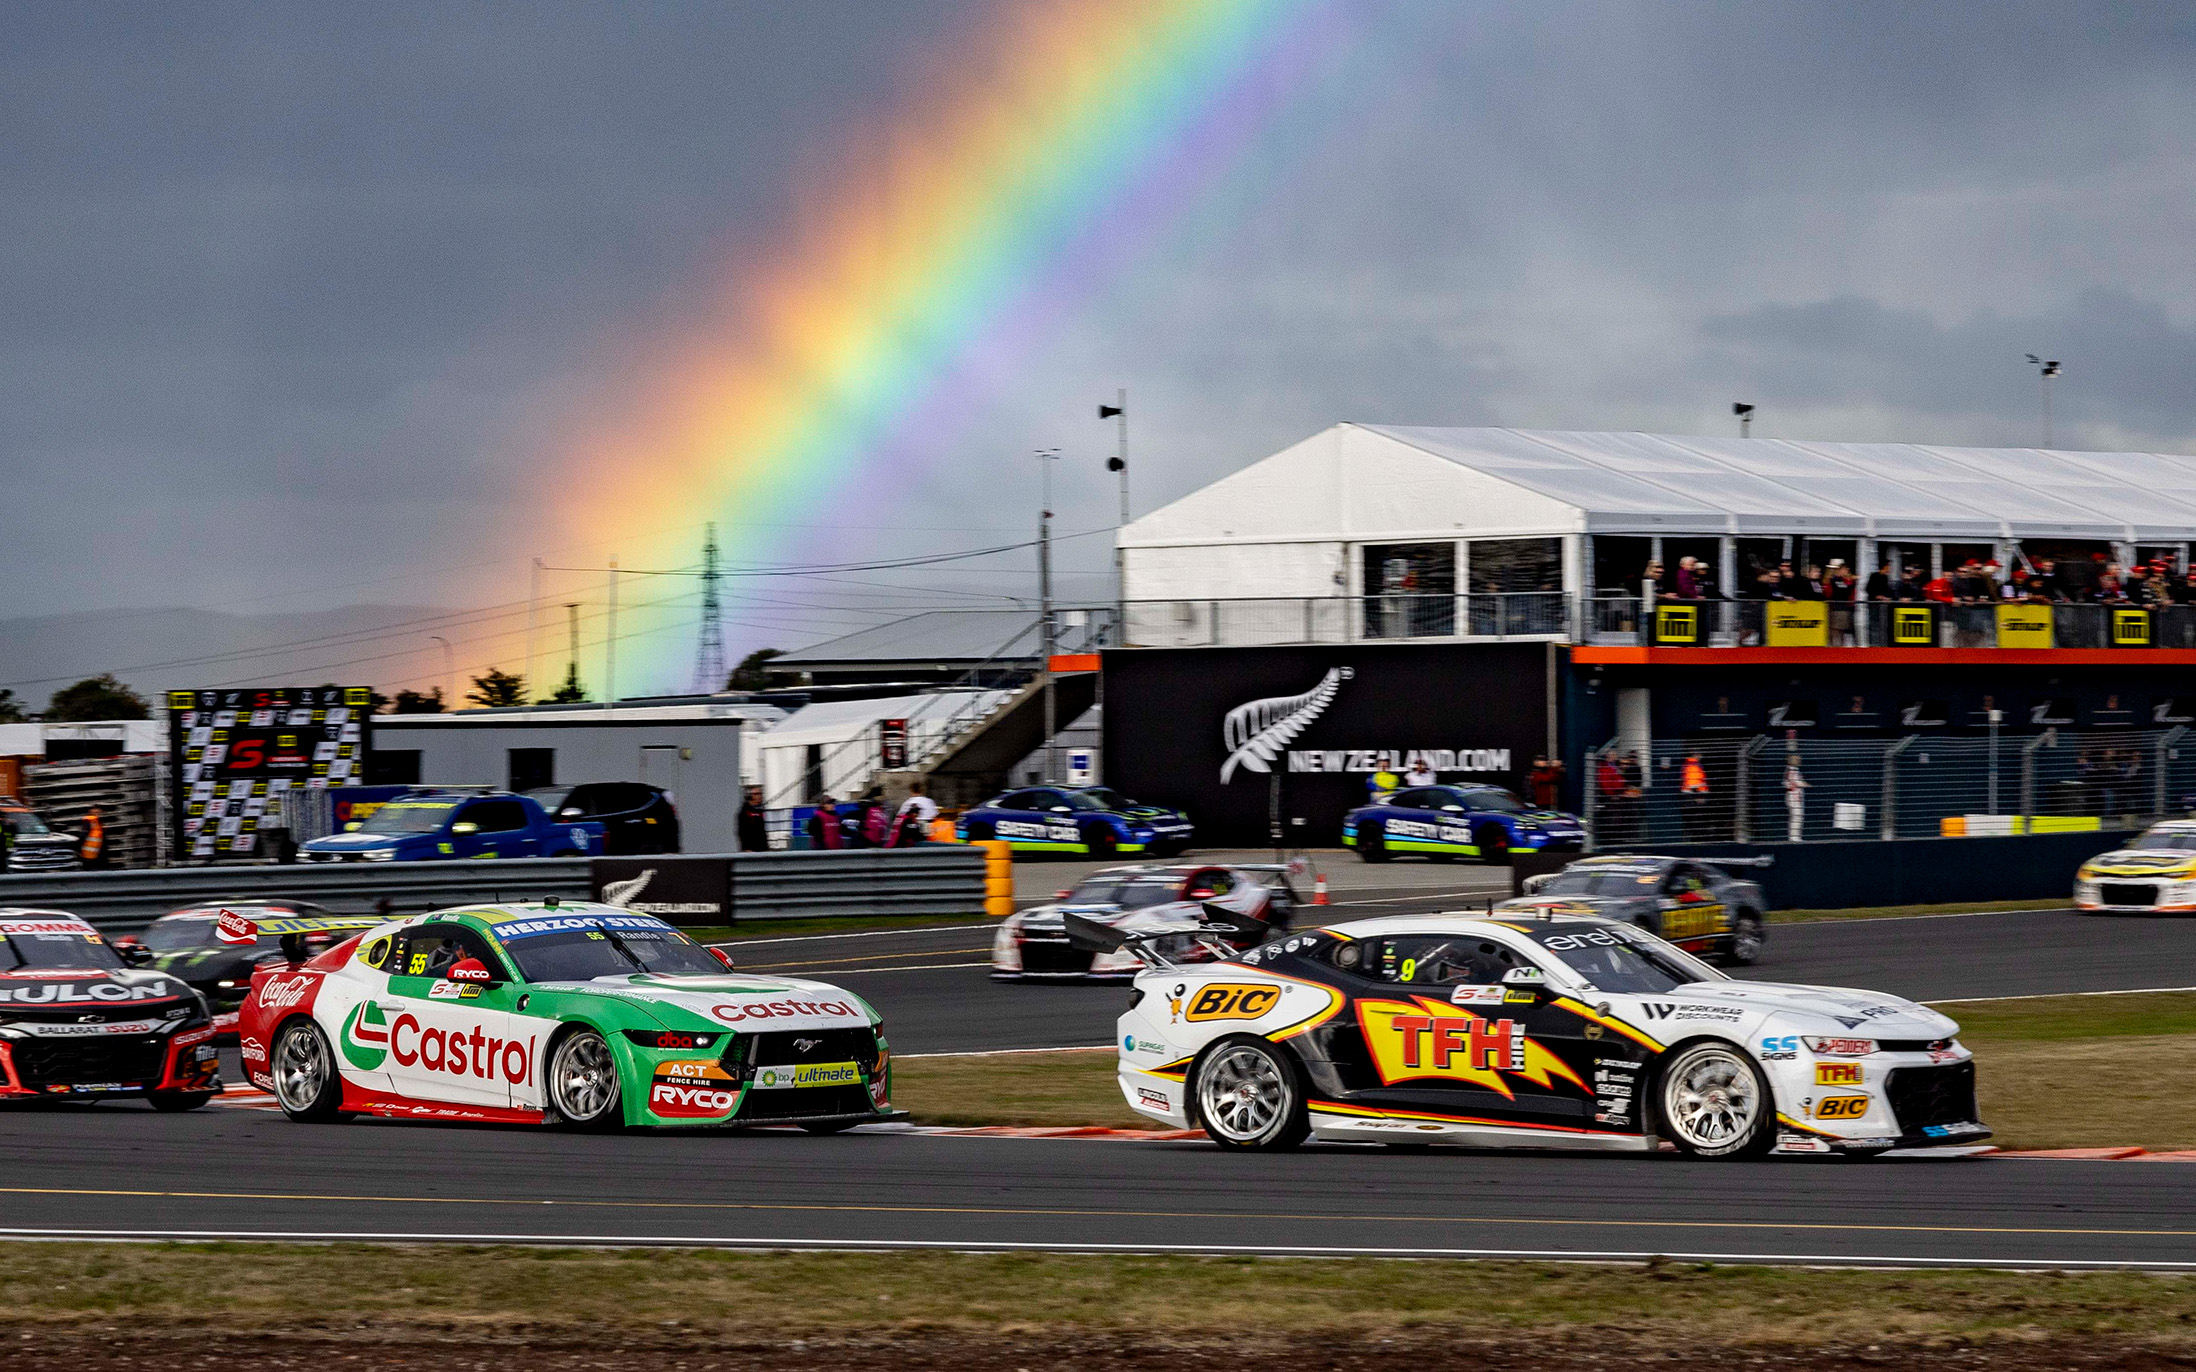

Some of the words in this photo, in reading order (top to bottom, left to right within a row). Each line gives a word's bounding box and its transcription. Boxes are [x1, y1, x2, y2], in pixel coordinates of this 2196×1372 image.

[494, 917, 604, 937] HERZOG
[609, 918, 672, 930] STEEL
[586, 931, 605, 940] 55
[617, 931, 661, 940] Randle
[408, 953, 428, 974] 55
[1401, 958, 1416, 981] 9
[454, 969, 490, 978] RYCO
[711, 999, 859, 1022] Castrol
[37, 1026, 99, 1035] BALLARAT
[104, 1023, 150, 1033] ISUZU
[657, 1032, 692, 1048] dba
[1391, 1015, 1515, 1071] TFH
[1761, 1036, 1799, 1052] SS
[391, 1013, 536, 1087] Castrol
[1760, 1052, 1797, 1060] SIGNS
[669, 1064, 706, 1077] ACT
[778, 1073, 789, 1082] bp
[798, 1066, 854, 1082] ultimate
[1817, 1065, 1856, 1081] TFH
[693, 1078, 710, 1086] HIRE
[653, 1085, 733, 1109] RYCO
